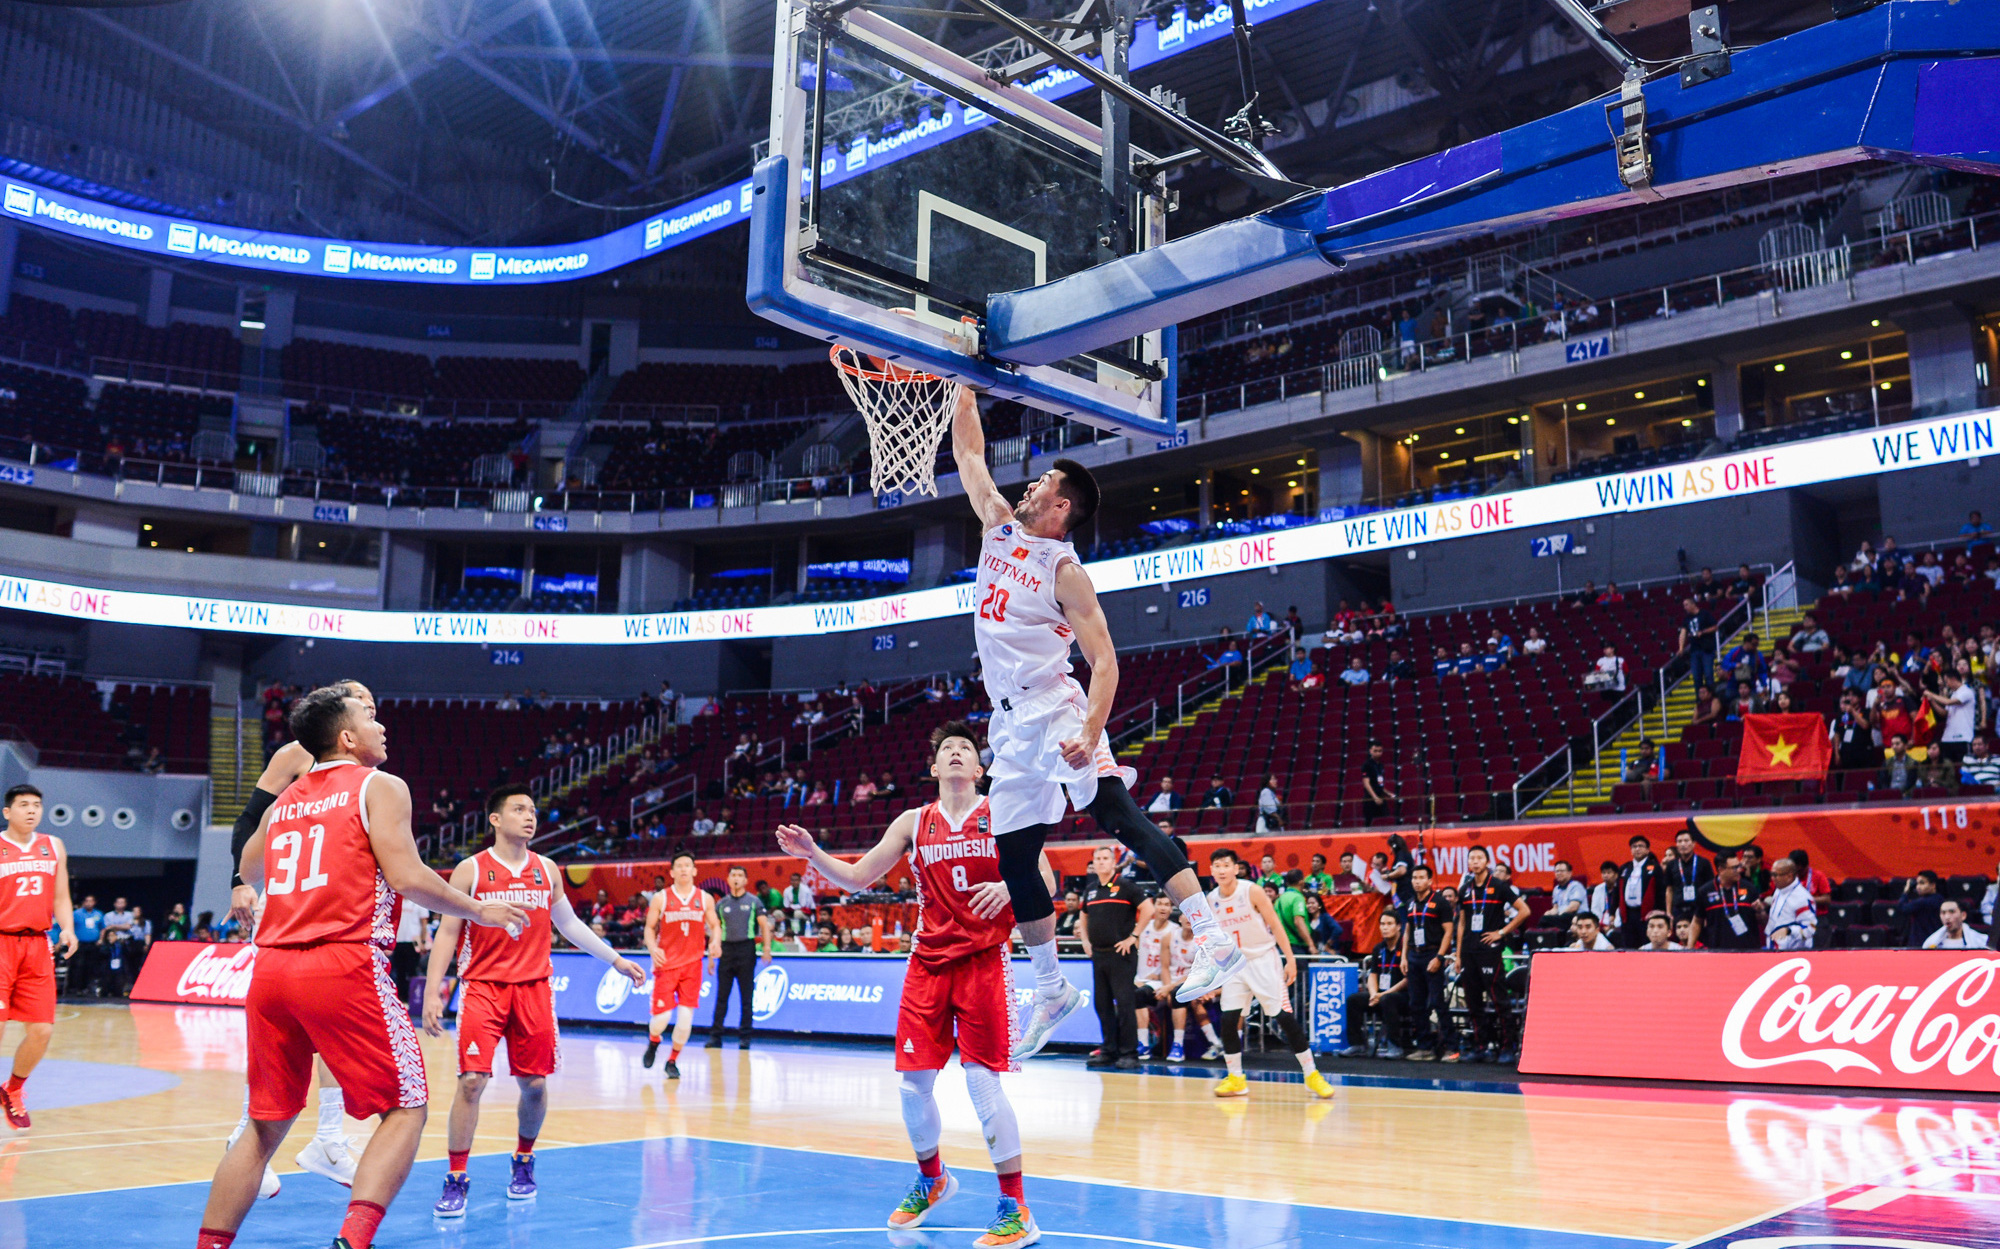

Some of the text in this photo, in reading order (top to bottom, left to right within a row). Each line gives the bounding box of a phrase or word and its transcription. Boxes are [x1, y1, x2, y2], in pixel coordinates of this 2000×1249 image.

[36, 197, 153, 241] MEGAWORLD
[663, 199, 732, 238] MEGAWORLD
[199, 233, 310, 264] MEGAWORLD
[352, 250, 457, 275] MEGAWORLD
[496, 253, 588, 276] MEGAWORLD
[1571, 338, 1605, 361] 417
[1872, 418, 1993, 465] WE WIN
[1682, 466, 1715, 497] AS
[1724, 456, 1776, 491] ONE
[1344, 498, 1514, 548] WE WIN AS ONE
[984, 553, 1041, 593] VIETNAM
[1134, 537, 1276, 582] WE WIN AS ONE
[0, 579, 111, 615] IN AS ONE
[859, 603, 879, 622] AS
[881, 598, 907, 621] ONE
[980, 582, 1010, 622] 20
[1182, 589, 1206, 607] 216
[186, 601, 219, 623] WE
[227, 605, 269, 626] WIN
[308, 612, 345, 633] ONE
[414, 616, 442, 636] WE
[450, 617, 488, 636] WIN
[524, 619, 559, 639] ONE
[624, 613, 754, 638] WE WIN AS ONE
[494, 651, 520, 664] 214
[875, 635, 893, 650] 215
[267, 824, 328, 895] 31
[918, 837, 997, 867] INDONESIA
[1513, 843, 1555, 873] ONE
[0, 860, 57, 879] NDONESIA
[952, 865, 968, 891] 8
[16, 876, 43, 896] 23
[788, 983, 884, 1003] SUPERMALLS
[1316, 970, 1330, 1037] SWEAT
[1327, 970, 1343, 1044] POCARI
[1722, 957, 2000, 1076] Coca-Co
